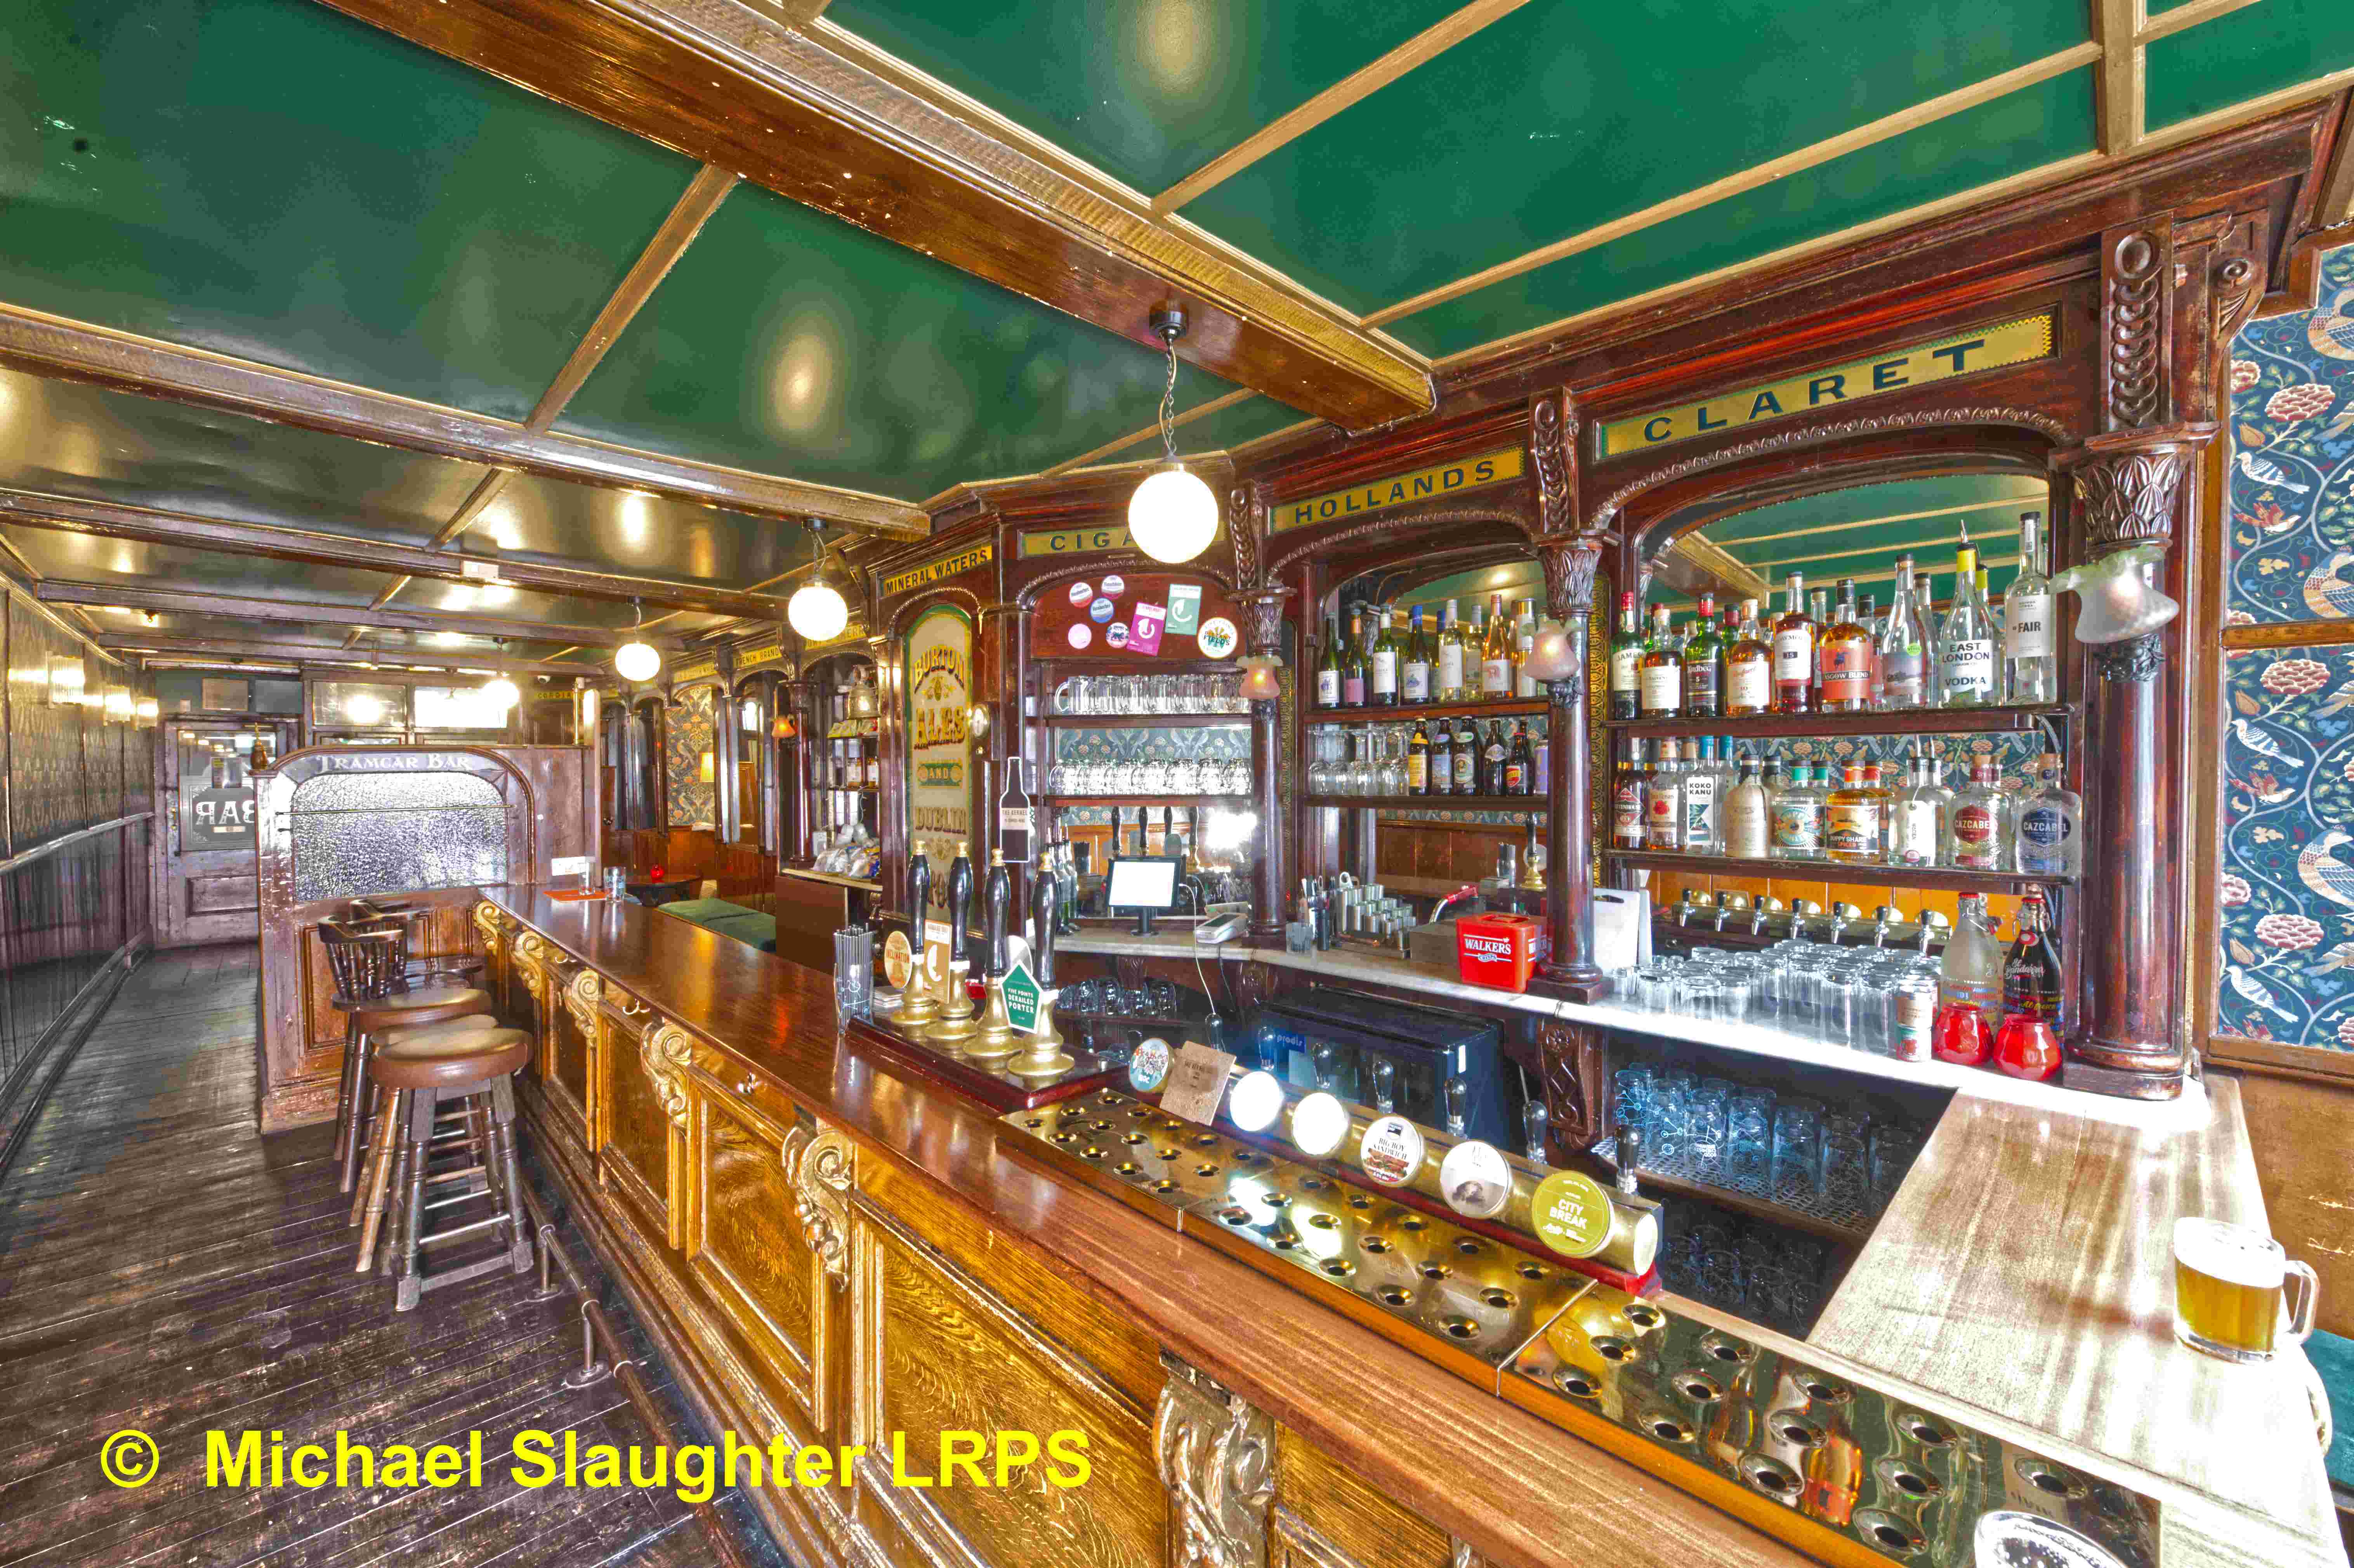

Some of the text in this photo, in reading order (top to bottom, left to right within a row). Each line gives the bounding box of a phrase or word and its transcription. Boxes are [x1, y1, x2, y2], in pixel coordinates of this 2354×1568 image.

[1644, 339, 1985, 443] CLARET
[1295, 461, 1494, 523] HOLLANDS
[1050, 532, 1134, 550] CIGA
[886, 549, 988, 594] MINERAL WATERS
[2018, 621, 2041, 633] FAIR
[1203, 634, 1230, 646] FIELDS
[760, 647, 781, 661] BRAND
[1950, 643, 1981, 653] EAST
[1617, 652, 1643, 662] JAMES
[1942, 652, 1990, 663] LONDON
[913, 645, 965, 694] BURTON
[1945, 677, 1986, 686] VODKA
[914, 706, 965, 749] ALES
[929, 767, 949, 780] AND
[915, 807, 967, 834] DUBLIN
[1954, 819, 1995, 830] CAZCABE
[1465, 938, 1512, 955] WALKERS
[1008, 994, 1034, 1005] DERAILED
[1018, 990, 1033, 998] POINTS
[1009, 1001, 1035, 1014] PORTER
[1373, 1143, 1408, 1160] SANDWICH
[1379, 1138, 1405, 1152] BIG BOY
[1559, 1199, 1584, 1216] CITY
[1549, 1206, 1588, 1230] BREAK
